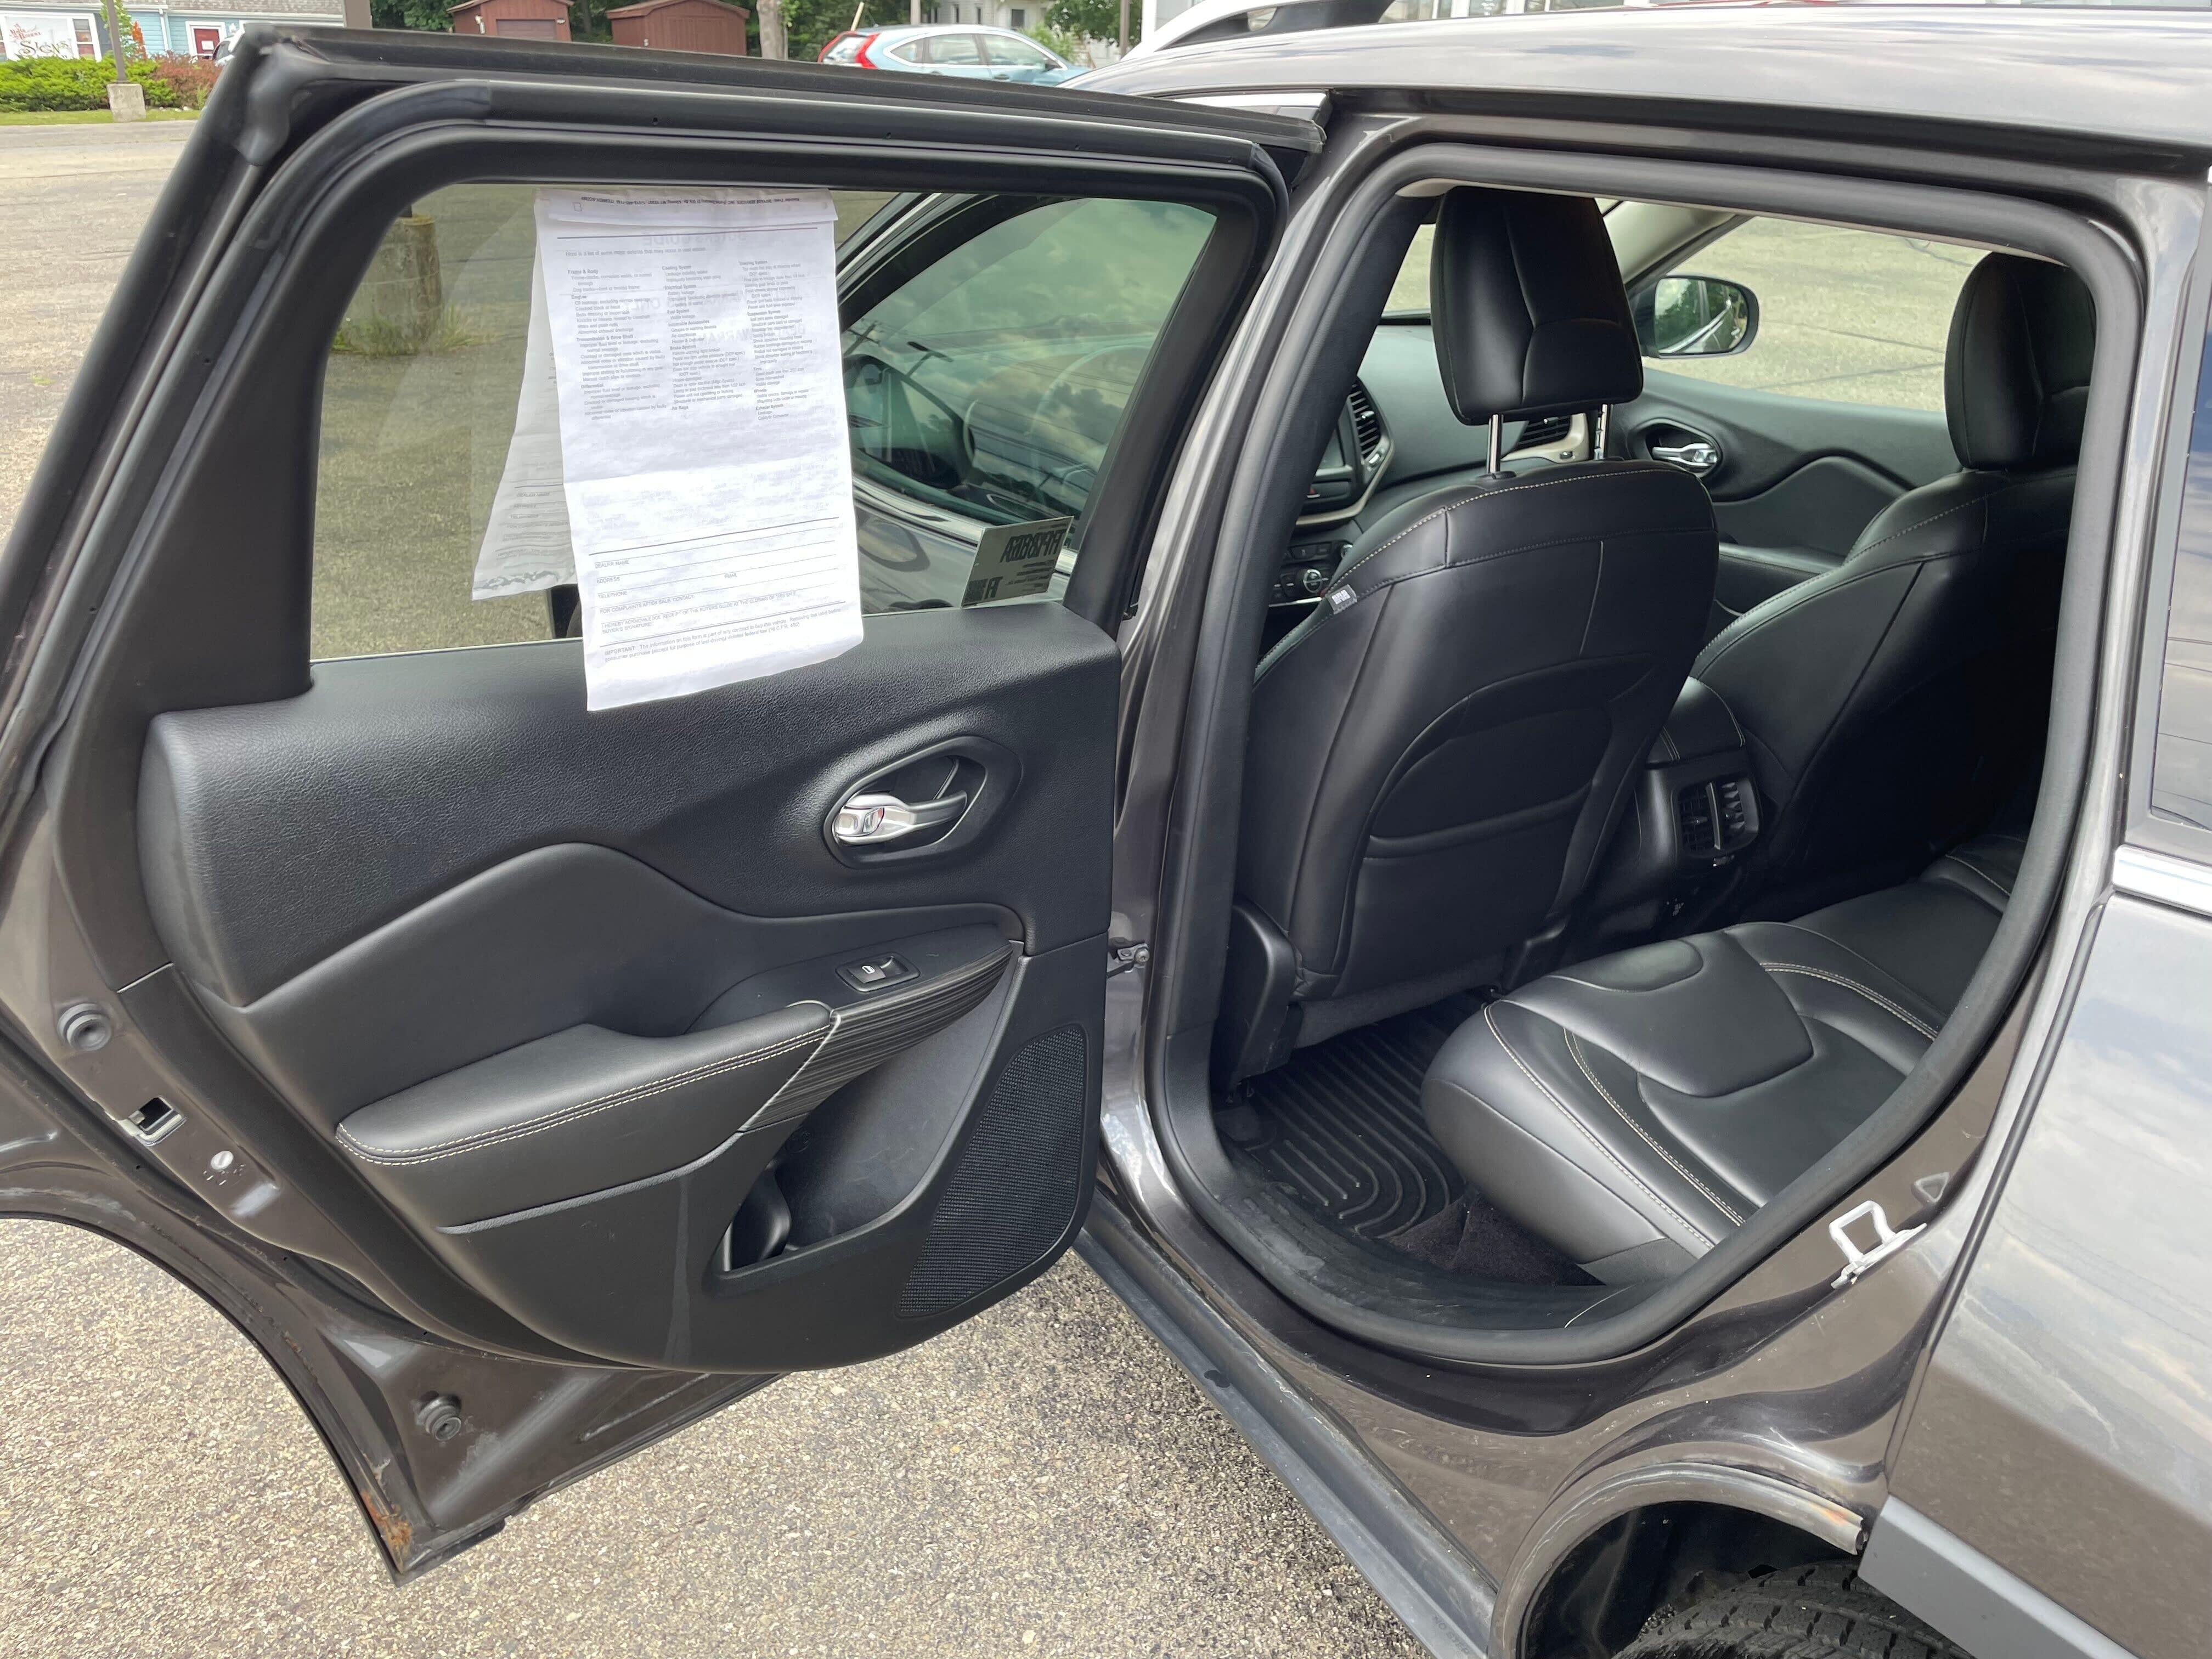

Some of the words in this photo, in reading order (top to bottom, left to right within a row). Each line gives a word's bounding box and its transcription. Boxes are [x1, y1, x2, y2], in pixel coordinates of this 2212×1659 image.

[595, 561, 614, 569] DEALER
[605, 620, 624, 628] HEREBY
[625, 614, 661, 624] ACKNOWLEDGE
[662, 611, 682, 619] RECEIPT
[749, 596, 769, 604] CLOSING
[611, 603, 642, 612] COMPLAINTS
[650, 639, 675, 647] information
[605, 653, 628, 662] consumer
[629, 650, 651, 658] purchase
[676, 642, 695, 651] purpose
